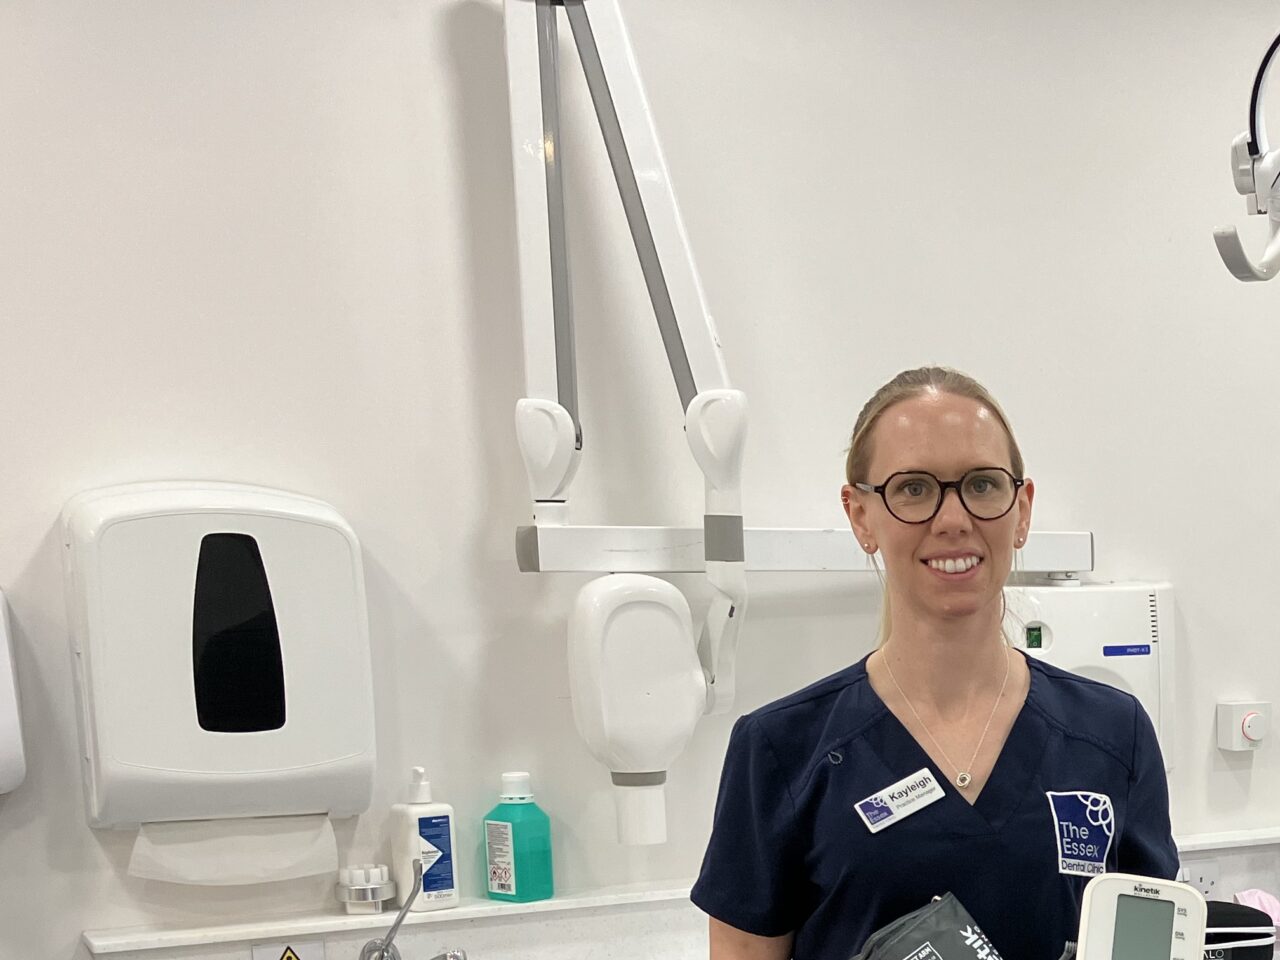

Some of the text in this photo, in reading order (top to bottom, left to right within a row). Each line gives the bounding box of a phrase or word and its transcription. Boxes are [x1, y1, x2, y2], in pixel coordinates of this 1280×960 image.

[888, 776, 932, 802] Kayleigh
[1059, 821, 1089, 839] The
[1062, 838, 1100, 858] Essex
[1061, 860, 1104, 874] Dental Clinic
[1133, 884, 1160, 895] kinetik
[918, 946, 932, 960] ARM
